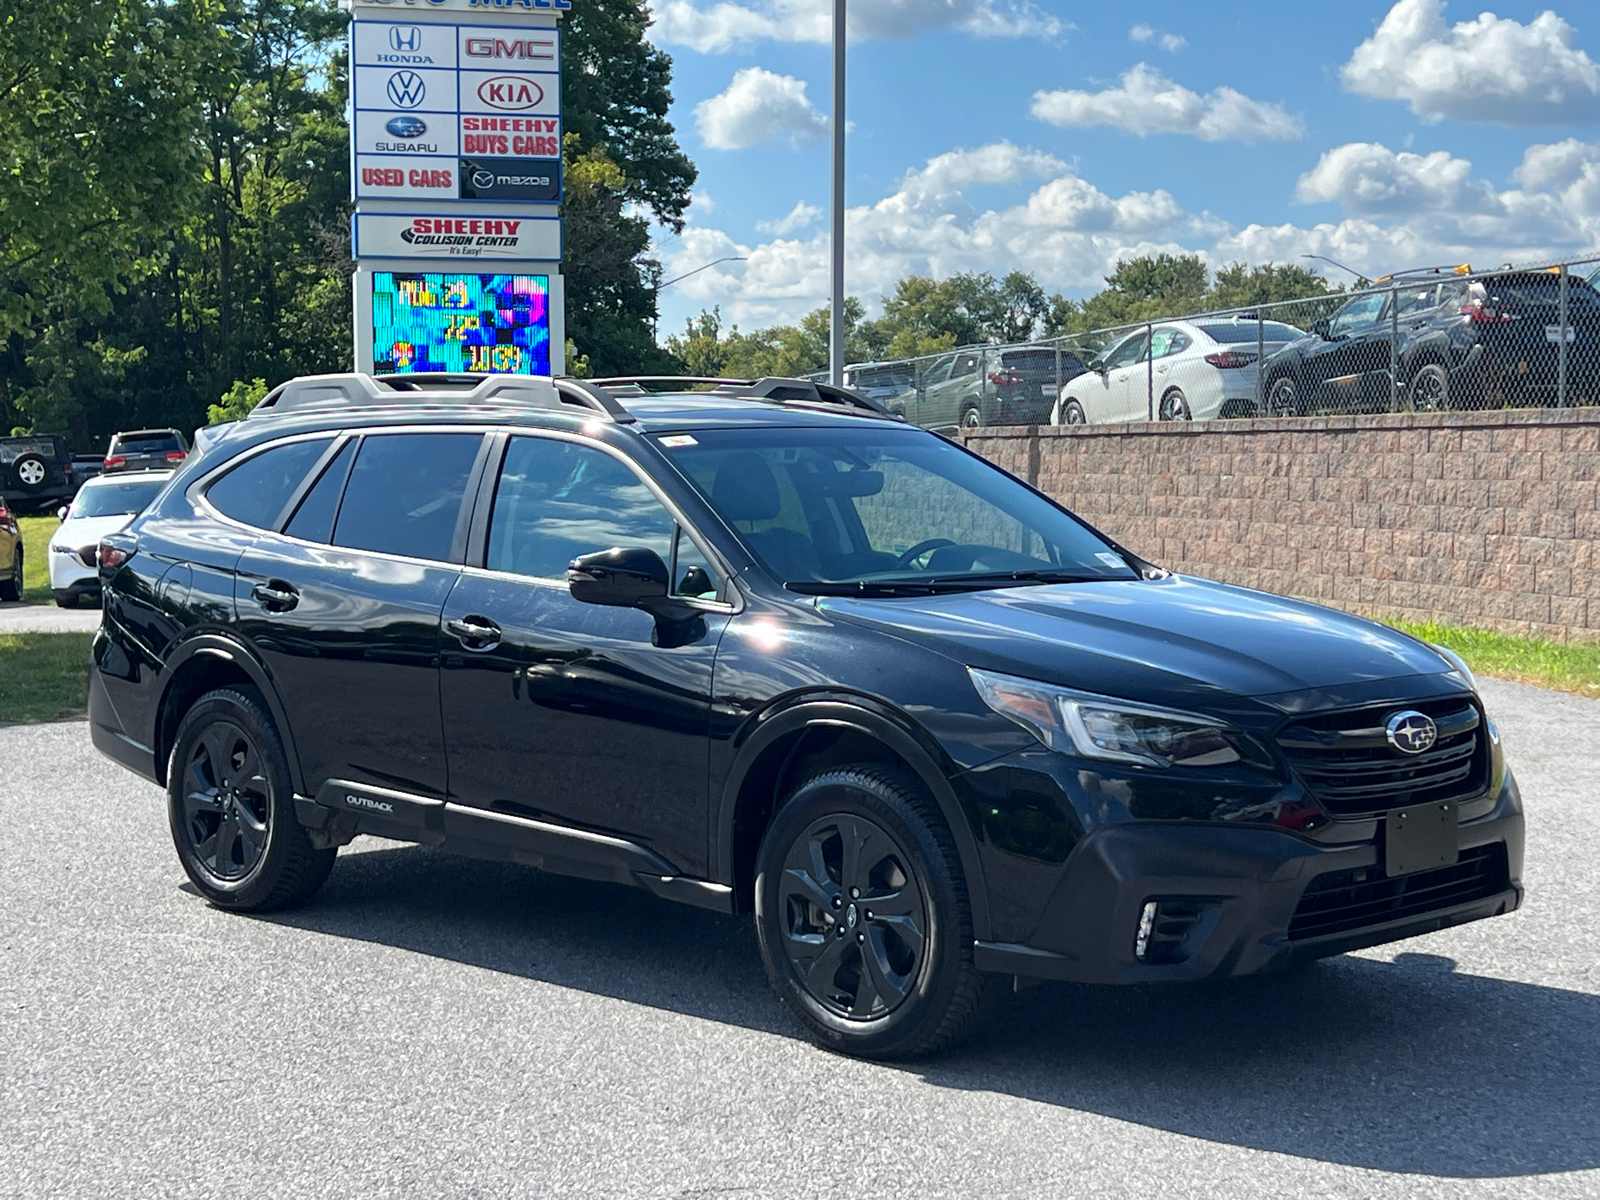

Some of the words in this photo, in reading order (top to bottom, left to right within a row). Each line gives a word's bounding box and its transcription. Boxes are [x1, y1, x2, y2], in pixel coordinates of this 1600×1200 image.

[466, 37, 554, 60] GMC
[377, 54, 434, 63] HONDA
[489, 83, 533, 103] KIA
[463, 117, 558, 132] SHEEHY
[375, 142, 438, 153] SUBARU
[464, 134, 508, 154] BUYS
[513, 136, 558, 156] CARS
[362, 168, 404, 187] USED
[409, 169, 452, 188] CARS
[497, 177, 550, 186] mazda
[413, 219, 521, 235] SHEEHY
[414, 235, 474, 245] COLLISION
[475, 237, 519, 246] CENTER
[462, 247, 483, 257] Easy!
[346, 795, 394, 812] OUTBACK
